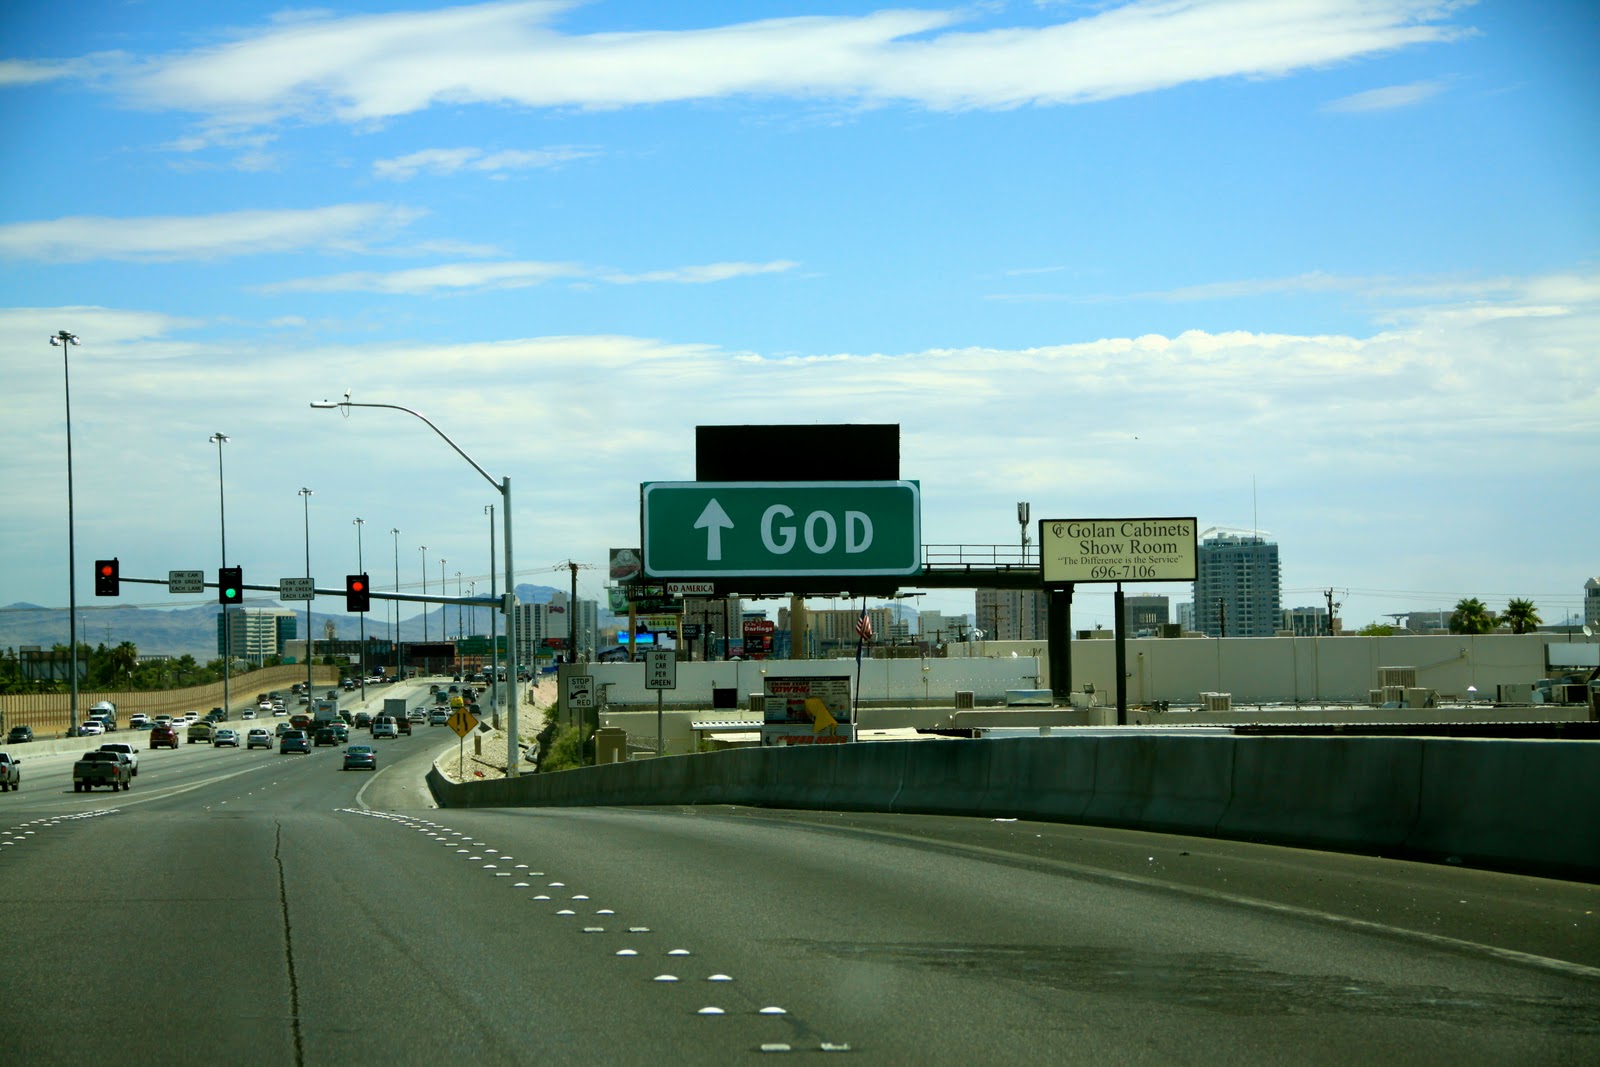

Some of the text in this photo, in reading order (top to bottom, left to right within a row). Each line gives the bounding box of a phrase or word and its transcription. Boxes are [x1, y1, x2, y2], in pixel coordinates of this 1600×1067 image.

[760, 504, 874, 555] GOD
[1067, 522, 1115, 538] Golan
[1120, 521, 1190, 537] Cabinets
[1080, 539, 1177, 555] Show Room
[1080, 556, 1122, 564] Difference
[1125, 556, 1132, 564] is
[1134, 555, 1147, 564] the
[1091, 565, 1156, 578] 696-7106
[681, 584, 713, 592] AMERICA
[571, 677, 590, 685] STOP
